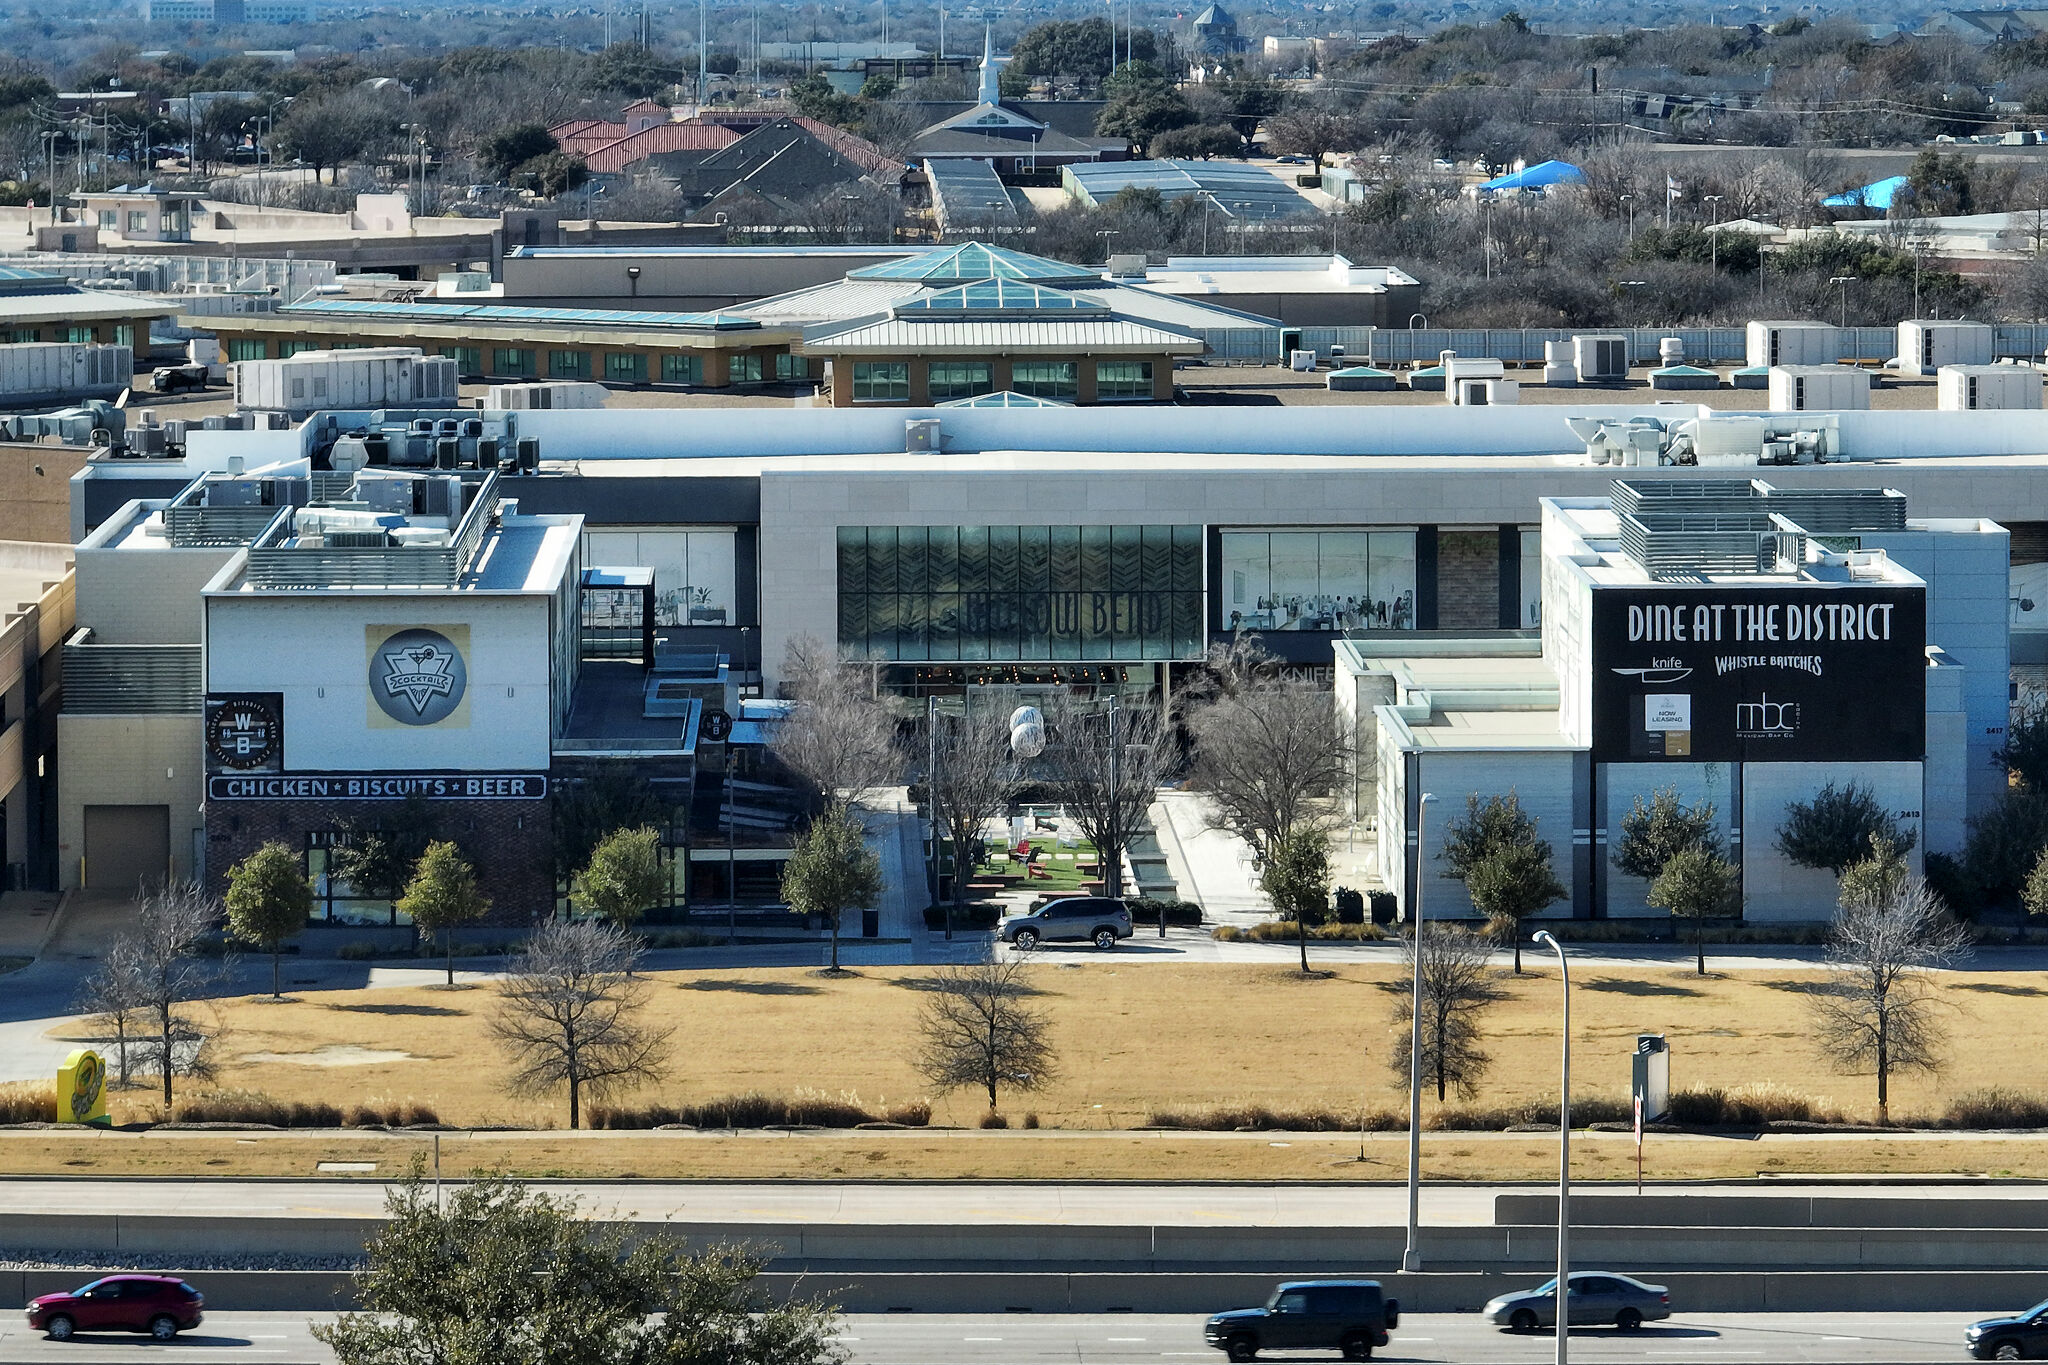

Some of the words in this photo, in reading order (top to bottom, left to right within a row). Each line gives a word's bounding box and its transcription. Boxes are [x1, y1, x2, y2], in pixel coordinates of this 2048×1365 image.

[966, 591, 1079, 635] WOW
[1092, 591, 1162, 635] BEND
[1628, 605, 1686, 641] DINE
[1693, 605, 1725, 641] AT
[1731, 604, 1779, 641] THE
[1787, 603, 1894, 641] DISTRICT
[1652, 657, 1682, 669] knife
[1715, 656, 1766, 677] WHISTLE
[1770, 655, 1822, 677] BRITCHES
[397, 675, 441, 685] COCKTAIL
[1278, 666, 1335, 684] KNIFE
[1736, 691, 1794, 729] mbc
[234, 713, 251, 730] W
[712, 715, 720, 724] W
[237, 737, 249, 754] B
[227, 780, 328, 796] CHICKEN
[348, 779, 446, 796] BISCUITS
[466, 779, 526, 795] BEER
